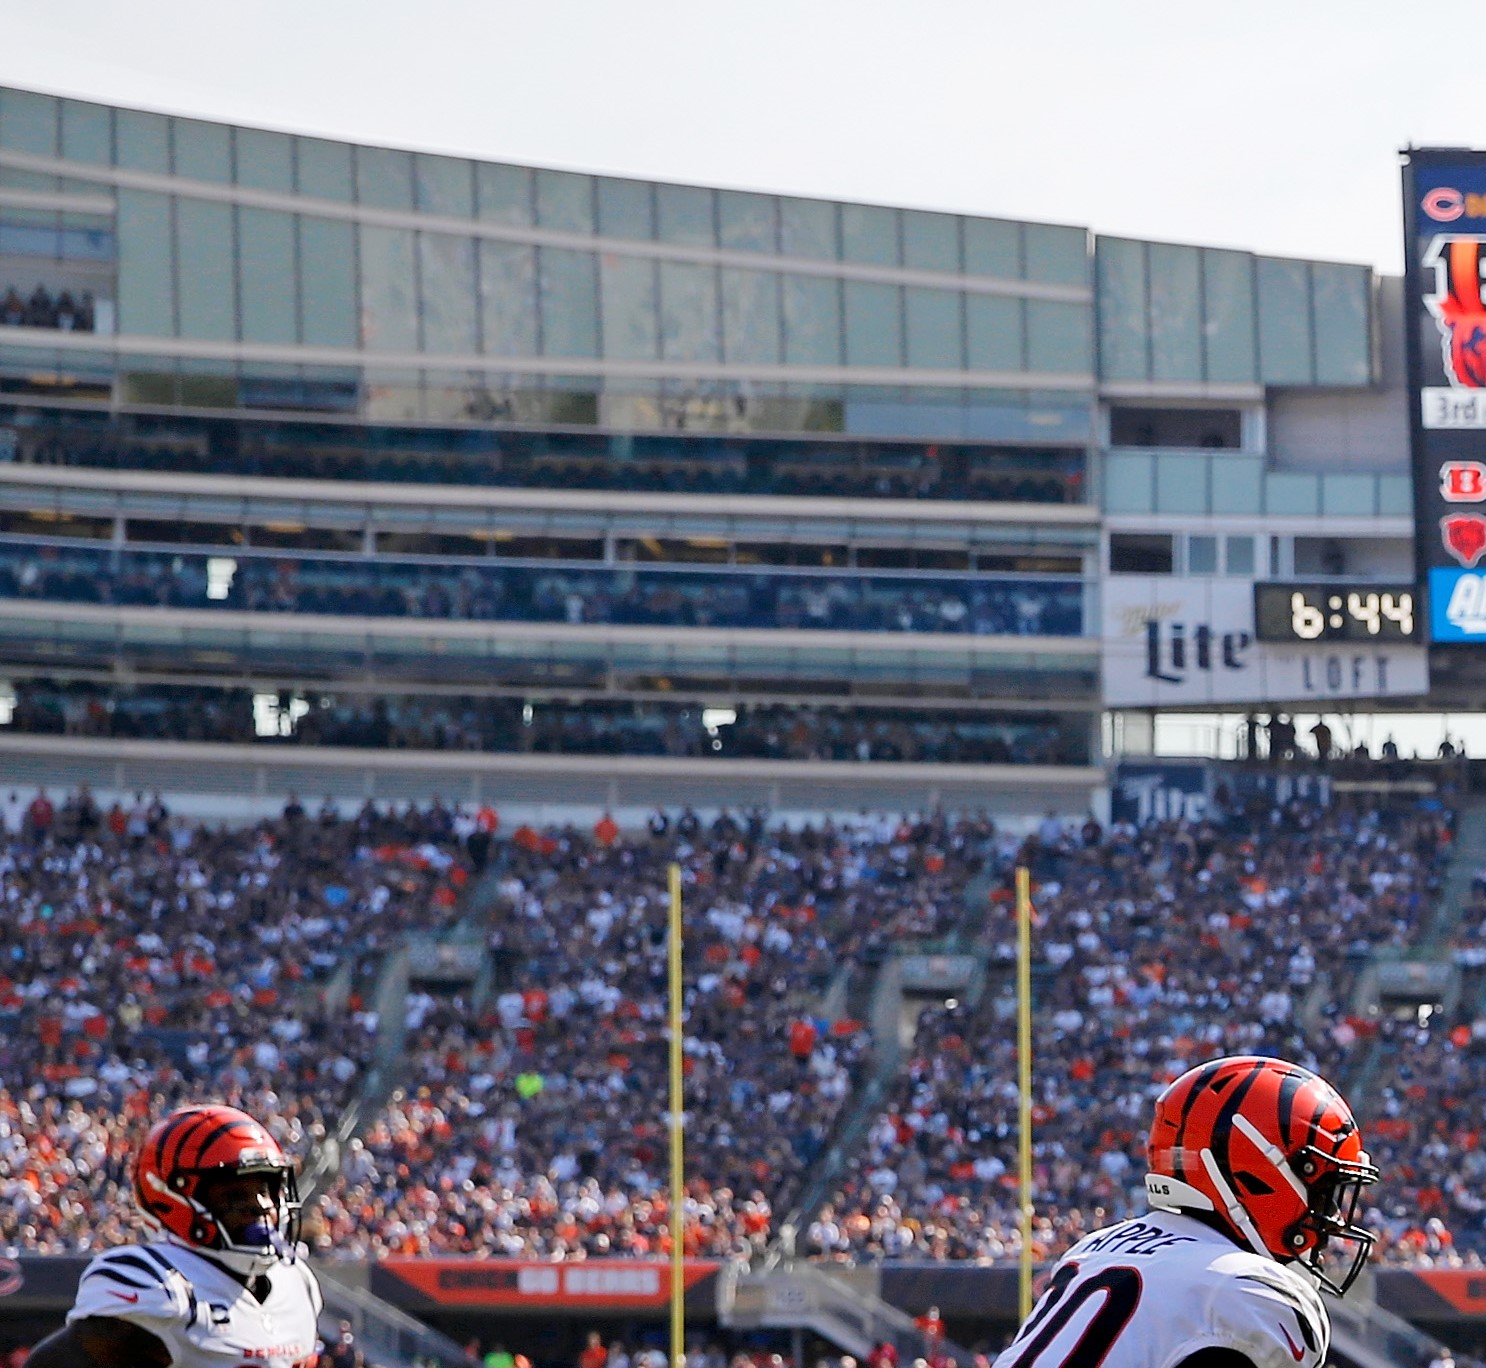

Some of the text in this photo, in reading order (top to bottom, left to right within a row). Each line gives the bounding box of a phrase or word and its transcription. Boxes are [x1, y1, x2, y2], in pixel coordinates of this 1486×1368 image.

[1291, 592, 1414, 639] 6:44
[1146, 617, 1250, 685] Lite
[1301, 654, 1391, 693] LOFT
[1082, 1223, 1199, 1255] APPLE
